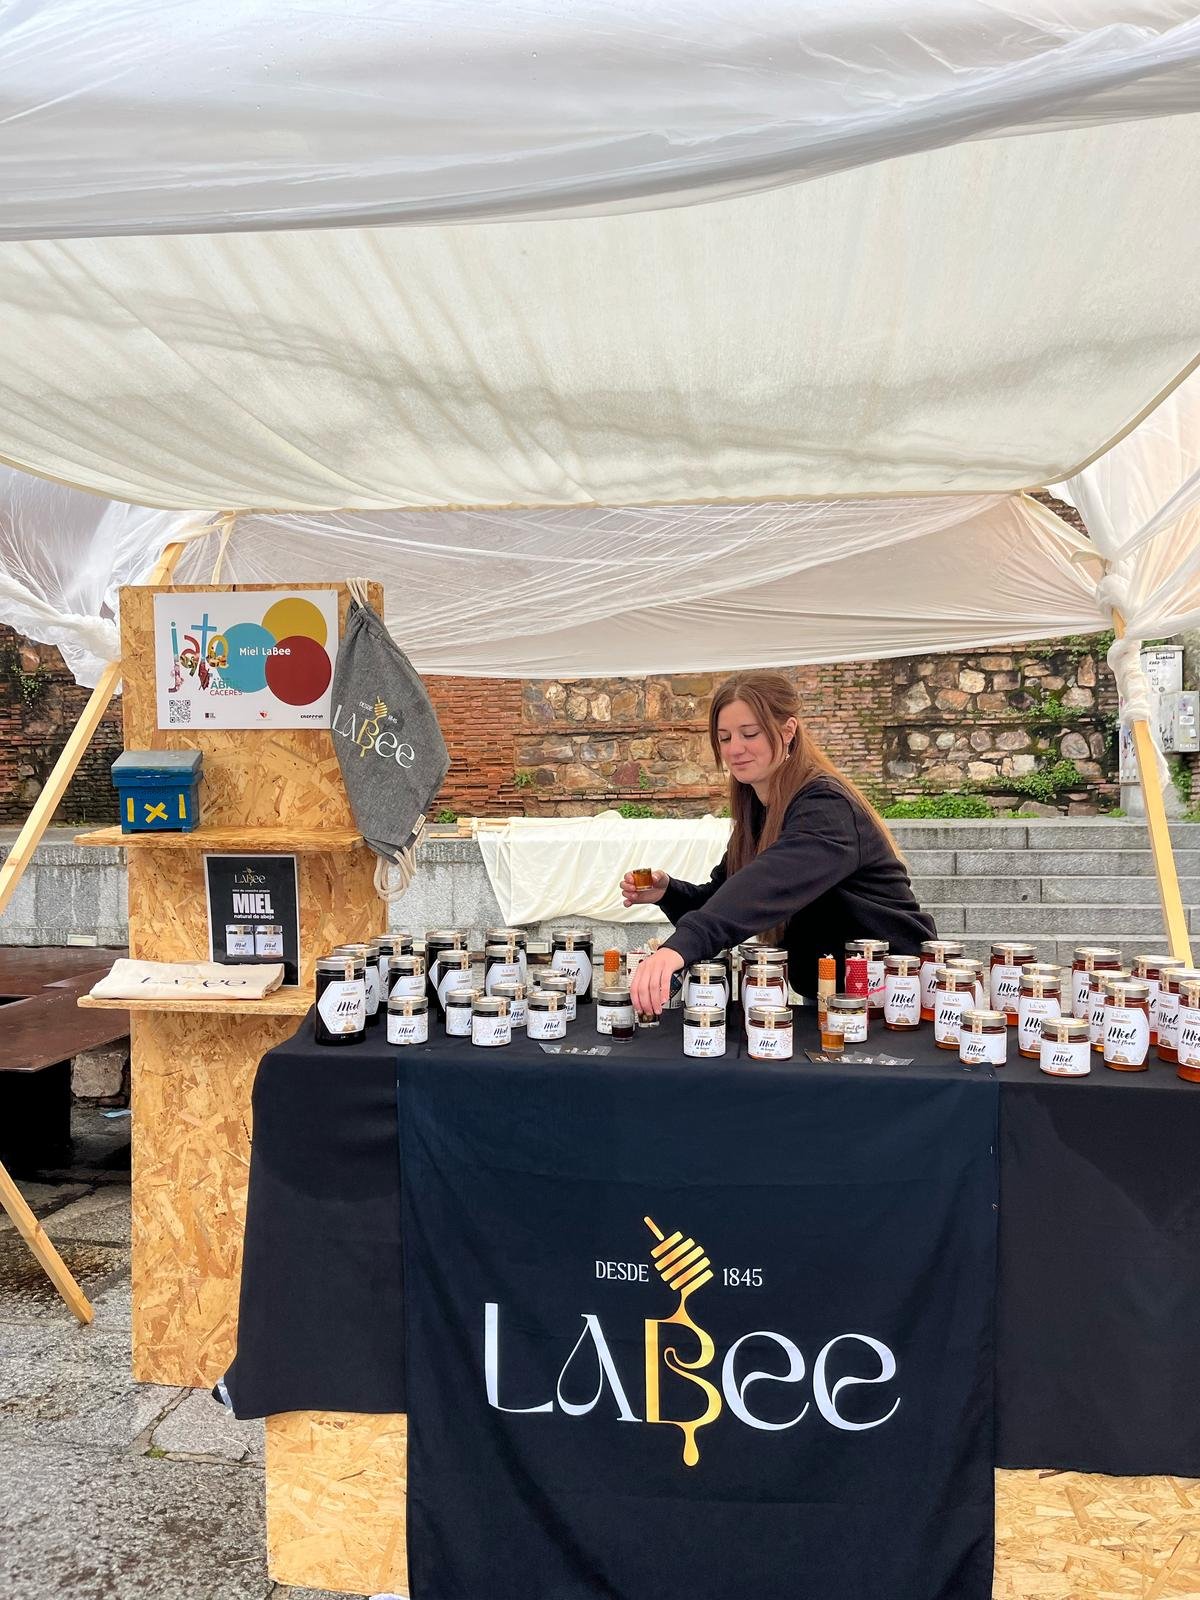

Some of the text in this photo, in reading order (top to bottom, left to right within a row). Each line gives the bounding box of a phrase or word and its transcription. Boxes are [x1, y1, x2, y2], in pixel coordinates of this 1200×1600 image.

[239, 646, 291, 656] Miel LaBee
[232, 893, 275, 914] MIEL
[999, 982, 1020, 993] Miel
[891, 993, 915, 1003] Miel
[336, 1000, 361, 1012] Miel
[511, 1009, 525, 1018] Miel
[939, 1009, 961, 1021] Mie
[1158, 1012, 1179, 1025] Miel
[543, 1020, 560, 1030] Miel
[1024, 1016, 1041, 1028] Mi
[398, 1026, 416, 1034] Miel
[493, 1025, 509, 1036] Miel
[1107, 1026, 1137, 1040] Miel
[1181, 1028, 1200, 1042] Mie
[694, 1038, 713, 1046] Miel
[966, 1043, 986, 1053] Miel
[1052, 1054, 1074, 1063] Miel
[595, 1260, 650, 1283] DESDE
[722, 1267, 764, 1288] 1845
